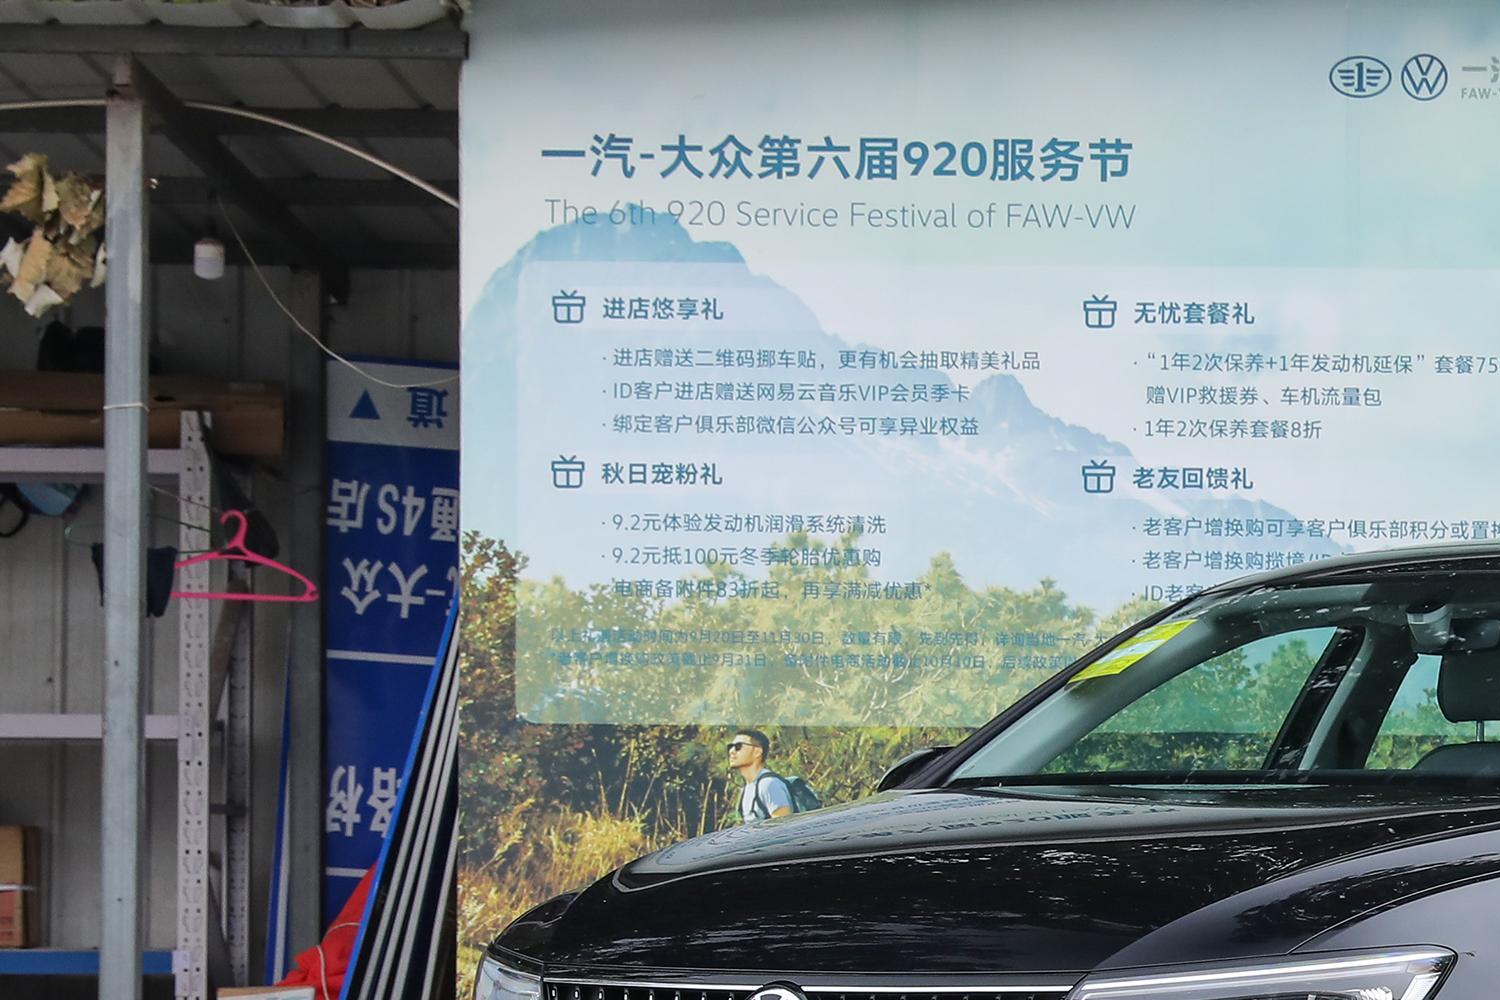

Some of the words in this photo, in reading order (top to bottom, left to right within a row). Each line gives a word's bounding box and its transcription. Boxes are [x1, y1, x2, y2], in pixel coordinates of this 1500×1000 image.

[541, 133, 1134, 183] 一汽-大众第六届920服务节
[544, 199, 598, 227] The
[609, 199, 657, 227] 6th
[667, 200, 727, 228] 920
[735, 201, 840, 229] Service
[850, 201, 958, 229] Festival
[967, 201, 998, 230] of
[1006, 202, 1137, 230] FAW-VW
[602, 297, 724, 321] 进店悠享礼
[1133, 301, 1256, 326] 无忧套餐礼
[612, 380, 971, 404] ID客户进店赠送网易云音乐VIP会员季卡
[612, 414, 980, 438] 绑定客户俱乐部微信公众号可享异业权益
[1144, 418, 1323, 441] 1年2次保养套餐8折
[601, 461, 724, 487] 秋日宠粉礼
[1132, 465, 1255, 491] 老友回馈礼
[612, 512, 888, 535] 9.2元体验发动机润滑系统清洗
